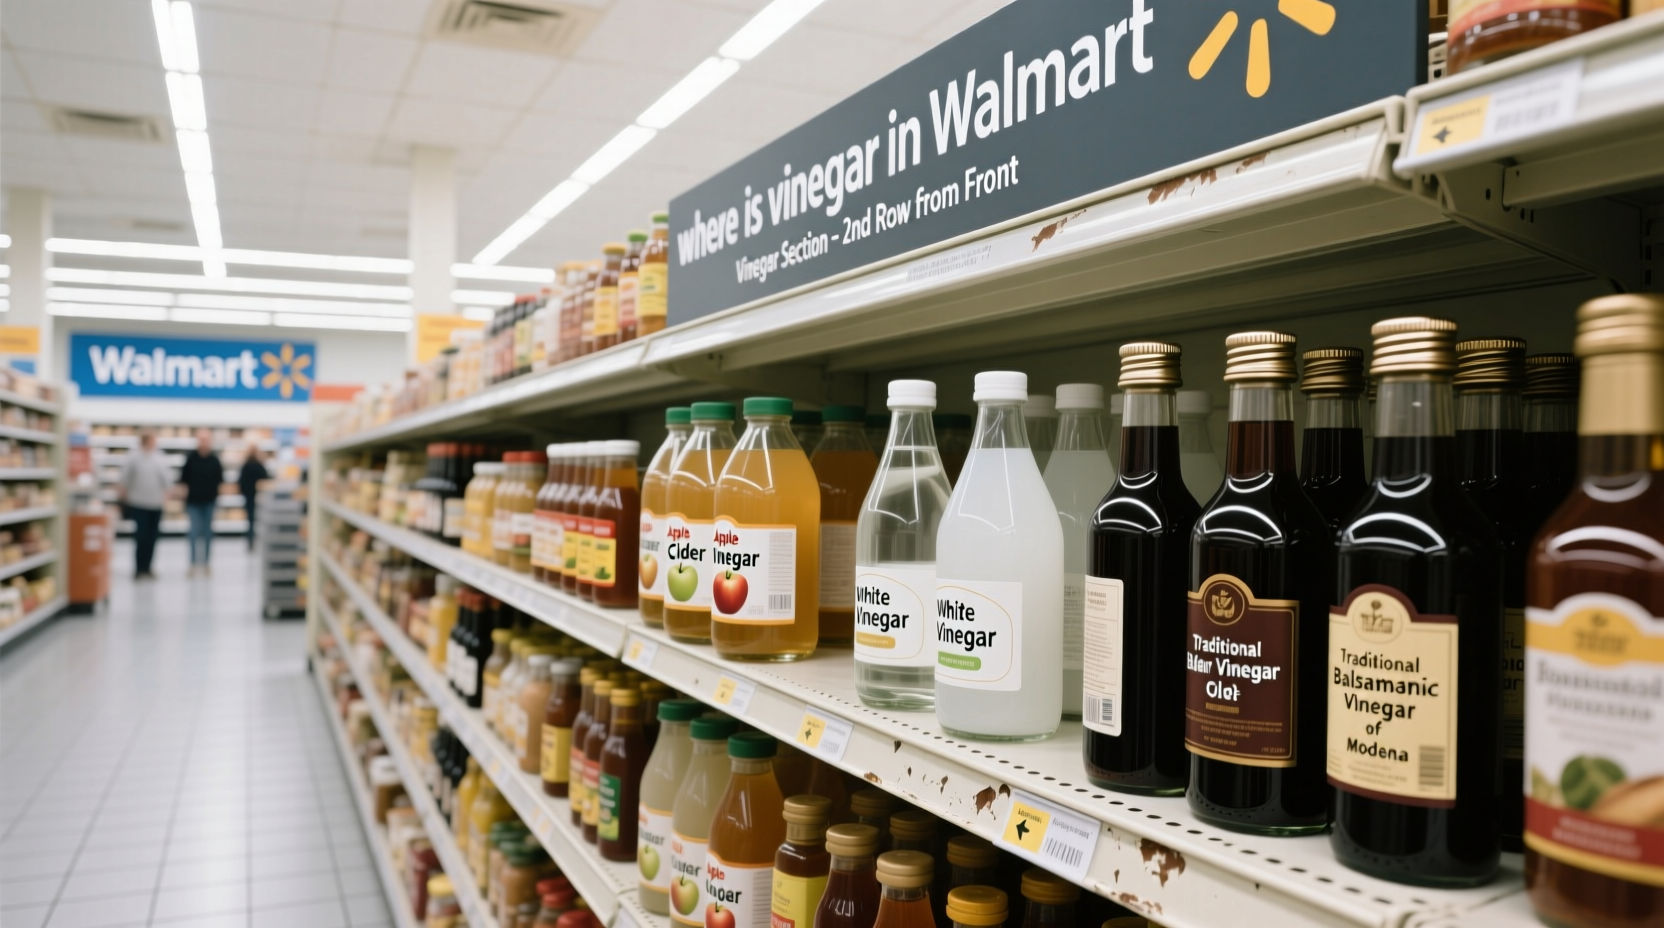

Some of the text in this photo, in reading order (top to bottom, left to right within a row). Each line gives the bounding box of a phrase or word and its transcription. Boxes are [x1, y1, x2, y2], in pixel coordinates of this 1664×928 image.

[677, 0, 1154, 267] where is vinegar in Walmart
[735, 252, 779, 284] Vinegar
[780, 231, 828, 269] Section
[842, 207, 872, 245] 2nd
[875, 200, 911, 234] Row
[915, 182, 960, 219] from
[965, 155, 1020, 202] Front
[88, 344, 259, 389] Walmart
[937, 599, 975, 622] White
[937, 620, 997, 652] Vinegar
[1215, 657, 1281, 684] Vinegar
[1340, 647, 1420, 673] Traditional
[1333, 666, 1439, 697] Balsamanic
[1365, 720, 1383, 736] of
[1346, 737, 1409, 762] Modena
